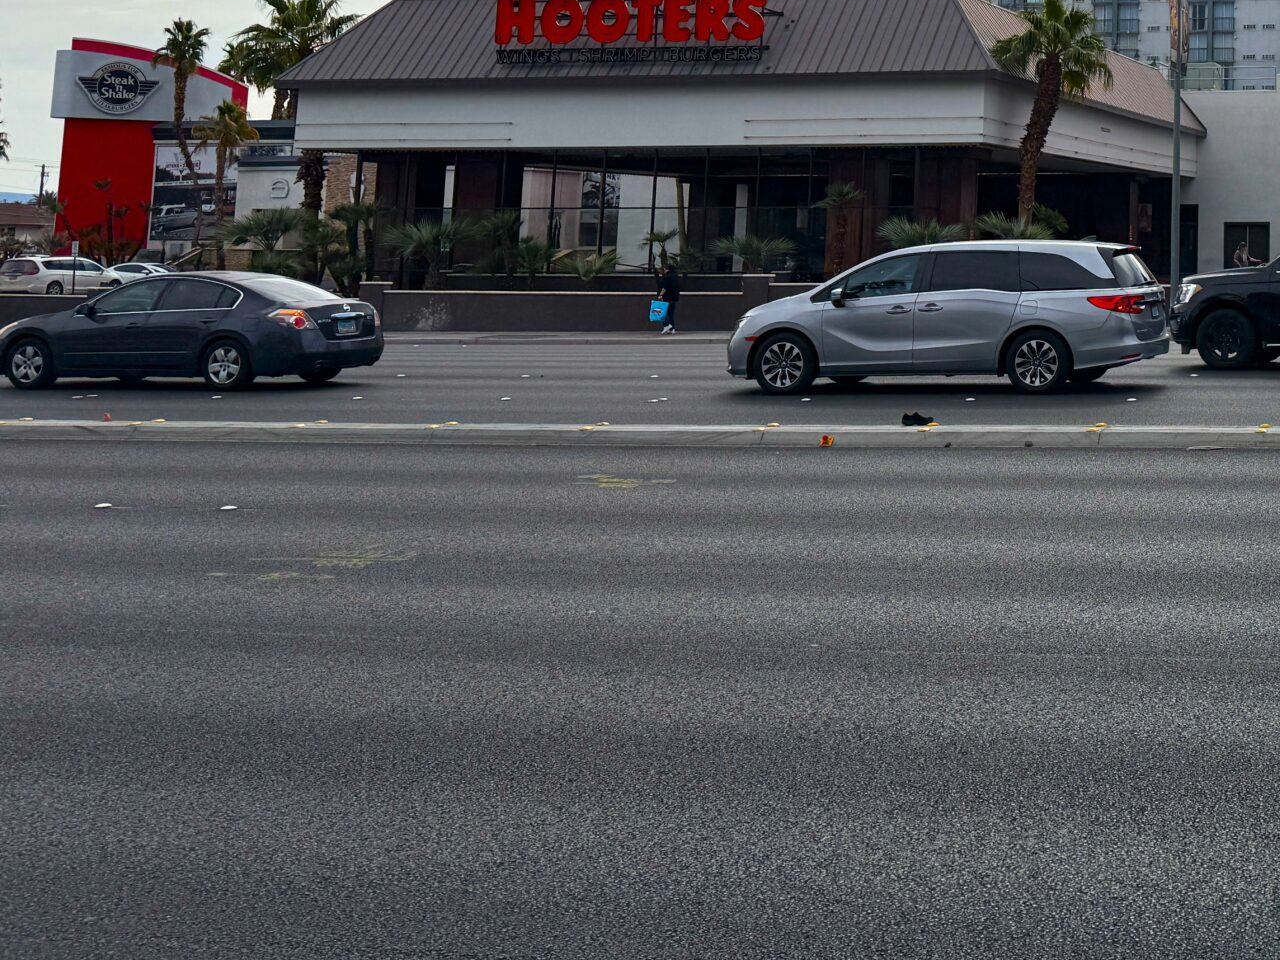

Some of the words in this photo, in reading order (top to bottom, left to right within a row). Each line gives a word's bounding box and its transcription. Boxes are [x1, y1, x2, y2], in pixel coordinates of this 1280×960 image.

[496, 49, 561, 64] WINGS
[578, 47, 651, 64] SHRIMP
[668, 46, 761, 62] BURGERS
[103, 73, 135, 85] Steak
[101, 87, 135, 99] Shake
